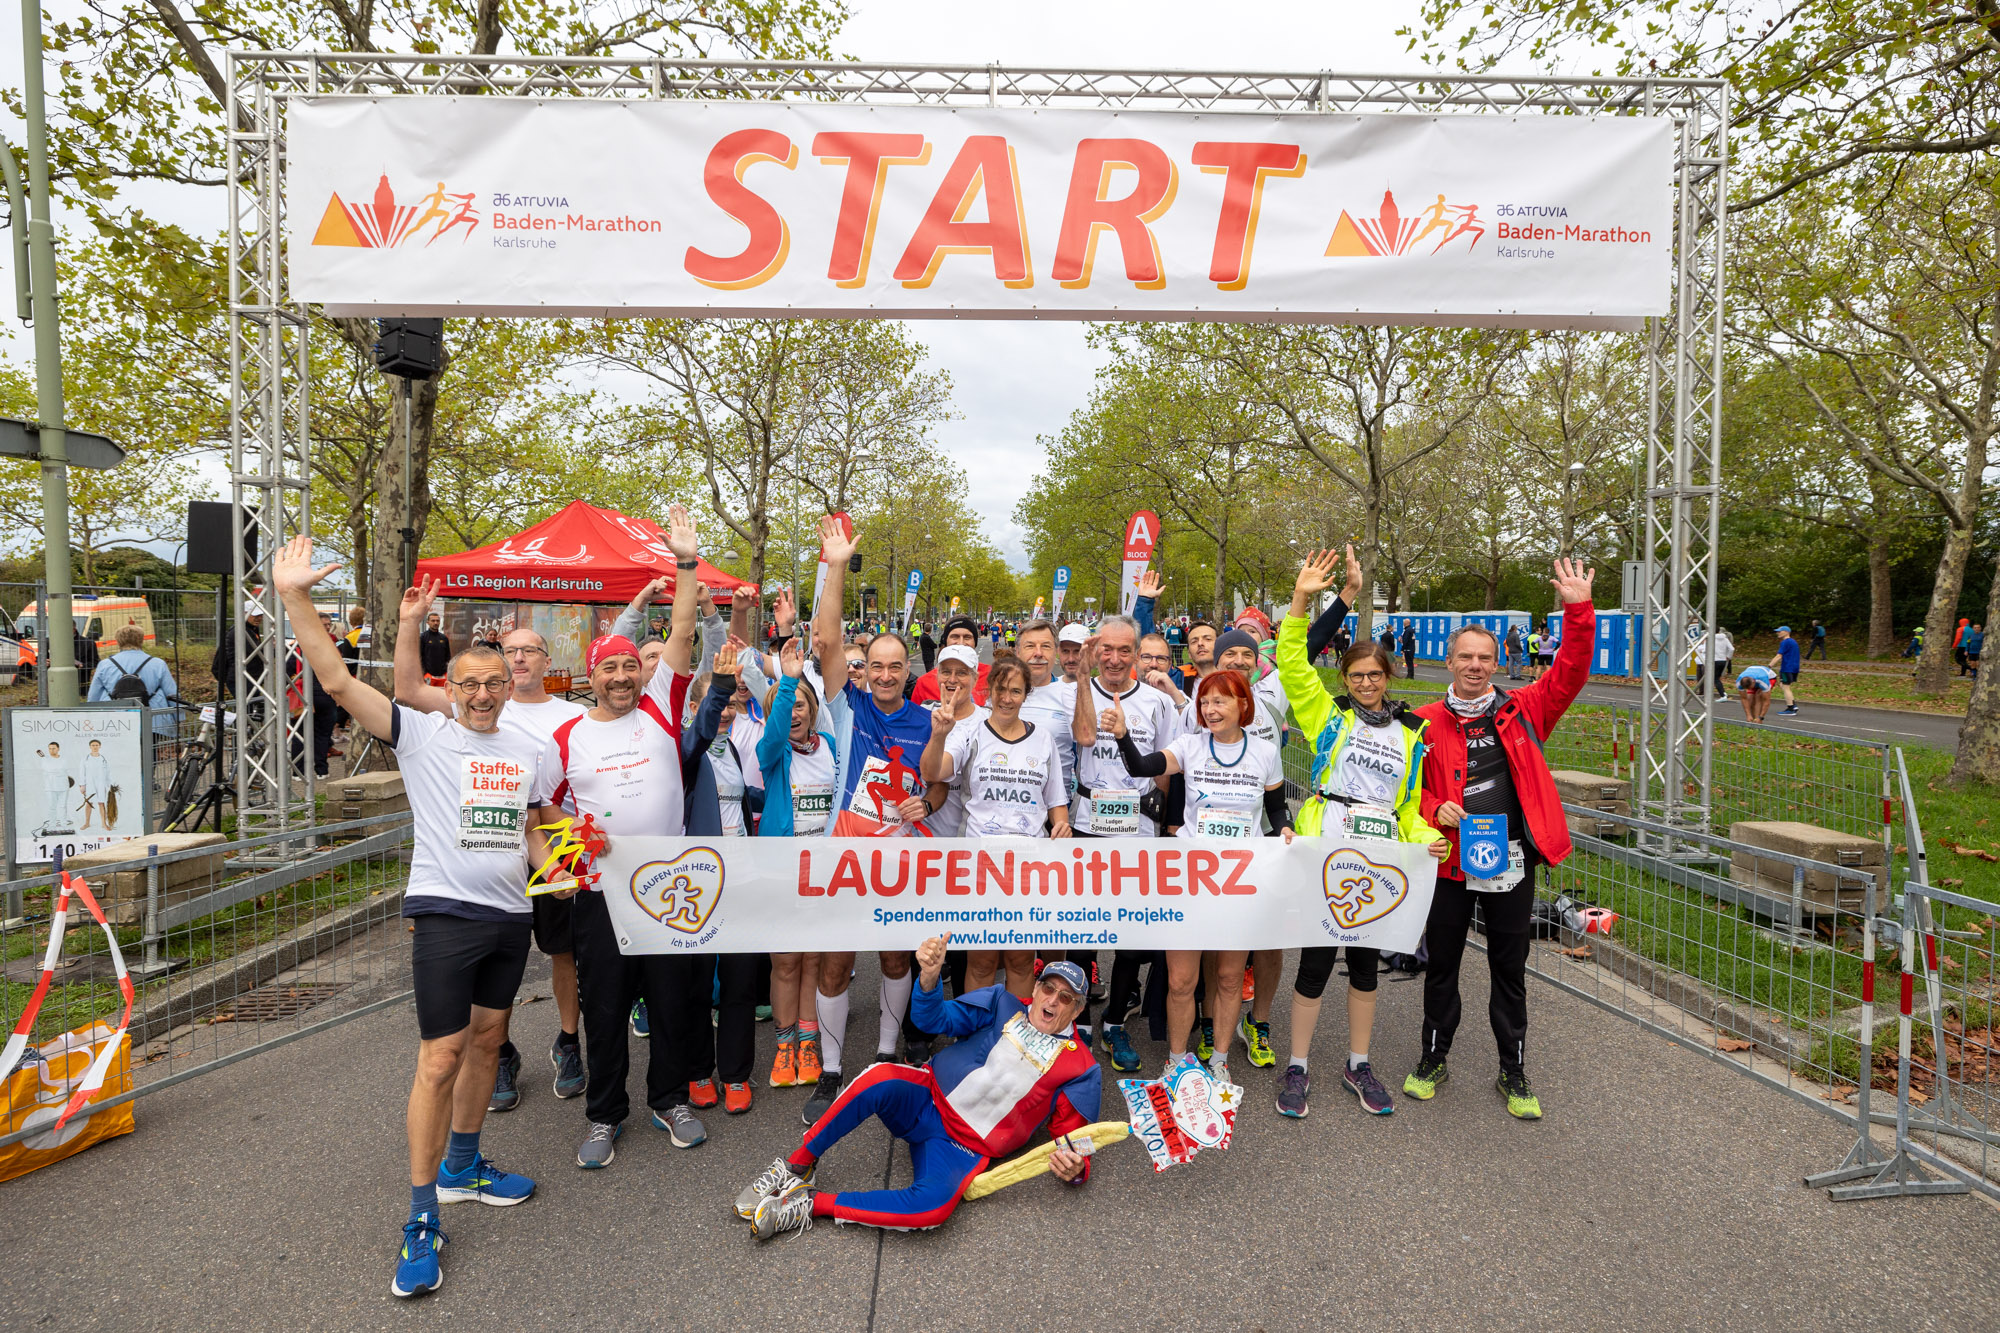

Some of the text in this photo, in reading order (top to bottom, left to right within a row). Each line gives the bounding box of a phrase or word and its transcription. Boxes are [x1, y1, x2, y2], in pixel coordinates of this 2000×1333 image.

[684, 128, 1308, 291] START
[492, 213, 662, 233] Baden-Marathon
[1497, 222, 1652, 244] Baden-Marathon
[492, 236, 557, 250] Karlsruhe
[1496, 246, 1555, 260] Karlsruhe
[1128, 516, 1153, 546] A
[1127, 551, 1148, 559] BLOCK
[447, 574, 604, 591] LG Region Karlsruhe
[910, 571, 920, 587] B
[1057, 568, 1068, 583] B
[1468, 727, 1486, 736] SSC
[894, 737, 923, 746] füreinander
[1373, 739, 1382, 748] für
[1092, 746, 1121, 760] AMA
[1355, 743, 1380, 756] Onkologie
[470, 761, 525, 776] Staffel-
[595, 765, 619, 774] Armin
[1345, 752, 1394, 775] AMAG
[978, 774, 989, 782] der
[990, 774, 1017, 784] Onkologie
[1018, 768, 1028, 776] die
[1242, 773, 1259, 781] Kinder
[472, 777, 521, 792] Läufer
[1204, 776, 1231, 786] Onkologie
[983, 787, 1031, 804] AMAG
[852, 803, 901, 825] Spendeläufer
[1099, 803, 1130, 816] 2929
[473, 810, 517, 827] 8316-3
[1090, 823, 1138, 834] Spendenläufer
[1208, 823, 1240, 838] 3397
[1358, 820, 1388, 835] 8260
[460, 838, 521, 850] Spendenläufer
[1478, 847, 1493, 865] K
[637, 862, 718, 897] LAUFEN mit HERZ
[797, 847, 1257, 898] LAUFENmitHERZ
[1330, 861, 1400, 898] LAUFEN mit HERZ
[873, 906, 1184, 927] Spendenmarathon für soziale Projekte
[670, 936, 684, 949] Ich
[684, 939, 699, 949] bin
[699, 925, 719, 947] dabei
[1320, 917, 1330, 930] Ich
[1328, 928, 1340, 939] bin
[1338, 932, 1361, 943] dabei
[1127, 1088, 1166, 1159] BRAVO!
